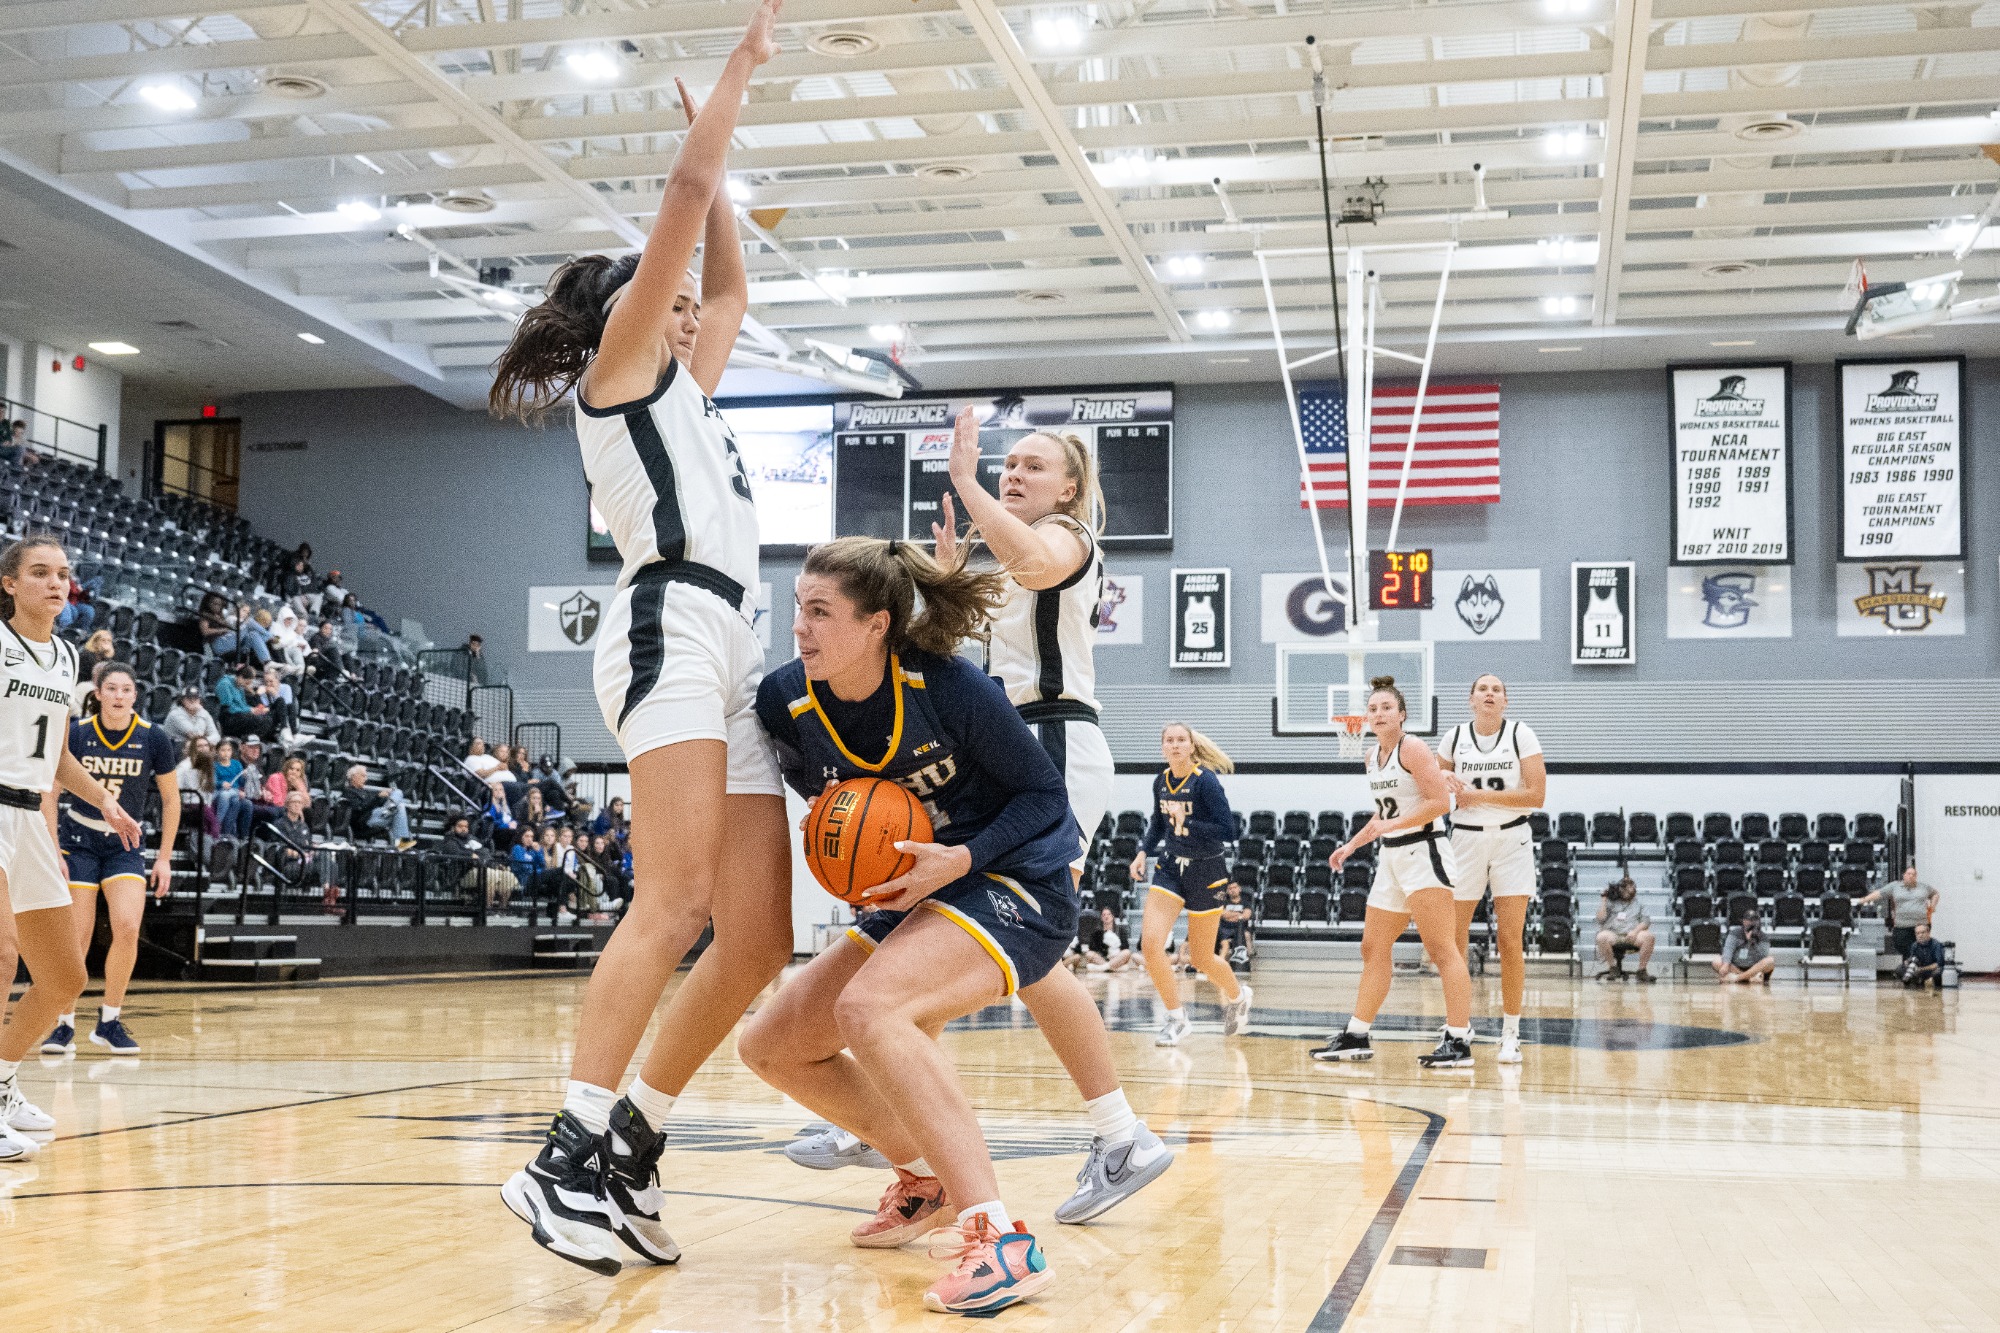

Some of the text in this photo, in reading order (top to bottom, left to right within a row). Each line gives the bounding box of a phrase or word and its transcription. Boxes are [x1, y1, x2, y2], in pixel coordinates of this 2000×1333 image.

[1696, 399, 1763, 415] PROVIDENCE
[1866, 394, 1937, 412] PROVIDENCE
[1072, 400, 1135, 420] FRIARS
[849, 405, 948, 430] PROVIDENCE
[1850, 414, 1953, 425] WOMENS BASKETBALL
[1680, 420, 1780, 430] WOMENS BASKETBALL
[923, 434, 950, 443] BIG
[1711, 434, 1748, 446] NCAA
[1877, 431, 1927, 442] BIG EAST
[918, 443, 953, 451] EAS
[1851, 442, 1952, 454] REGULAR SEASON
[1681, 448, 1780, 462] TOURNAMENT
[1868, 455, 1935, 465] CHAMPIONS
[922, 461, 950, 473] HOM
[1688, 466, 1771, 480] 1986 1989
[1850, 469, 1954, 484] 1983 1986 1990
[1688, 481, 1769, 494] 1990 1991
[1688, 496, 1721, 508] 1992
[1877, 493, 1927, 503] BIG EAST
[1862, 504, 1943, 516] TOURNAMENT
[1868, 517, 1936, 527] CHAMPIONS
[1713, 528, 1751, 540] WNIT
[1860, 532, 1893, 545] 1990
[1682, 543, 1783, 555] 1987 2010 2019
[1387, 552, 1428, 572] 7:10
[1382, 572, 1420, 604] 21
[1192, 622, 1208, 634] 25
[1596, 624, 1610, 637] 11
[27, 714, 48, 759] 1
[81, 755, 143, 777] SNHU
[1462, 761, 1514, 773] PROVIDENCE
[1944, 805, 2000, 817] RESTROO
[823, 790, 858, 859] ELITE
